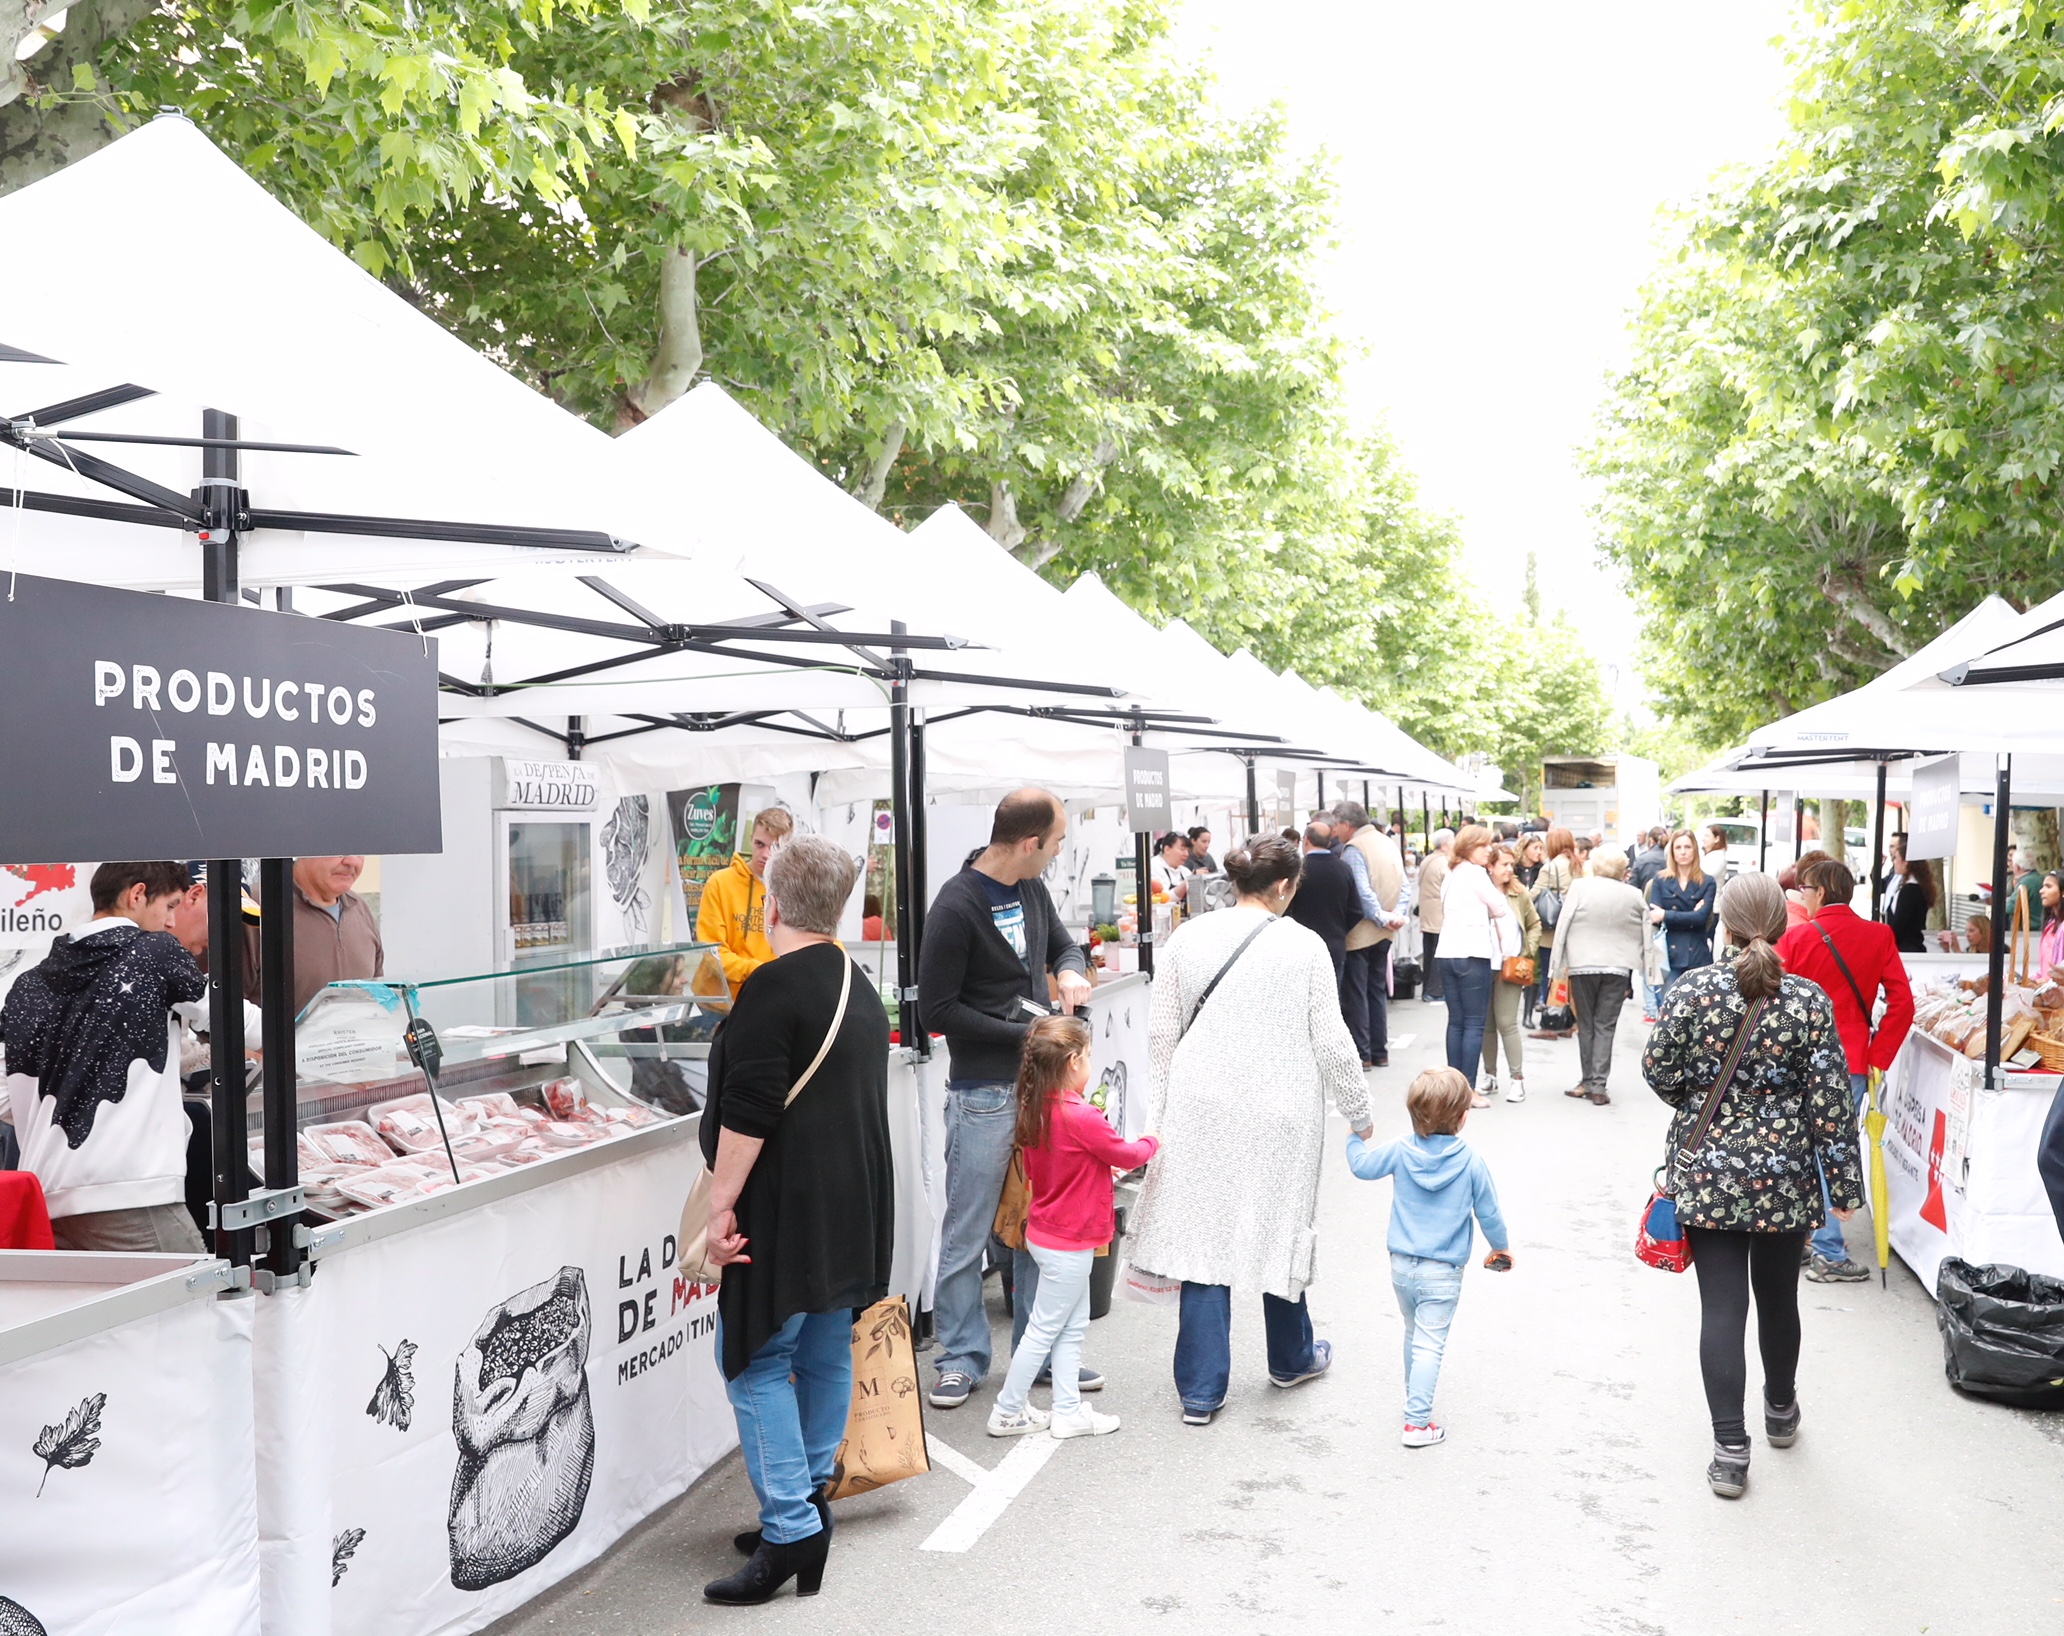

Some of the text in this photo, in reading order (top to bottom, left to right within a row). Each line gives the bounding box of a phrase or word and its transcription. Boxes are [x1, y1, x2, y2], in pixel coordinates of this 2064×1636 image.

[94, 660, 376, 728] PRODUCTOS
[110, 735, 368, 790] DE MADRID
[1133, 769, 1163, 785] PRODUCTOS
[511, 781, 595, 805] MADRID
[1136, 793, 1163, 808] DE MADRID
[687, 804, 714, 821] Zuves
[1, 908, 62, 932] ileño
[619, 1234, 676, 1289] LA D
[618, 1288, 657, 1344] DE
[618, 1330, 683, 1385] MERCADO
[857, 1376, 881, 1400] M
[854, 1405, 890, 1418] PRODUCTO
